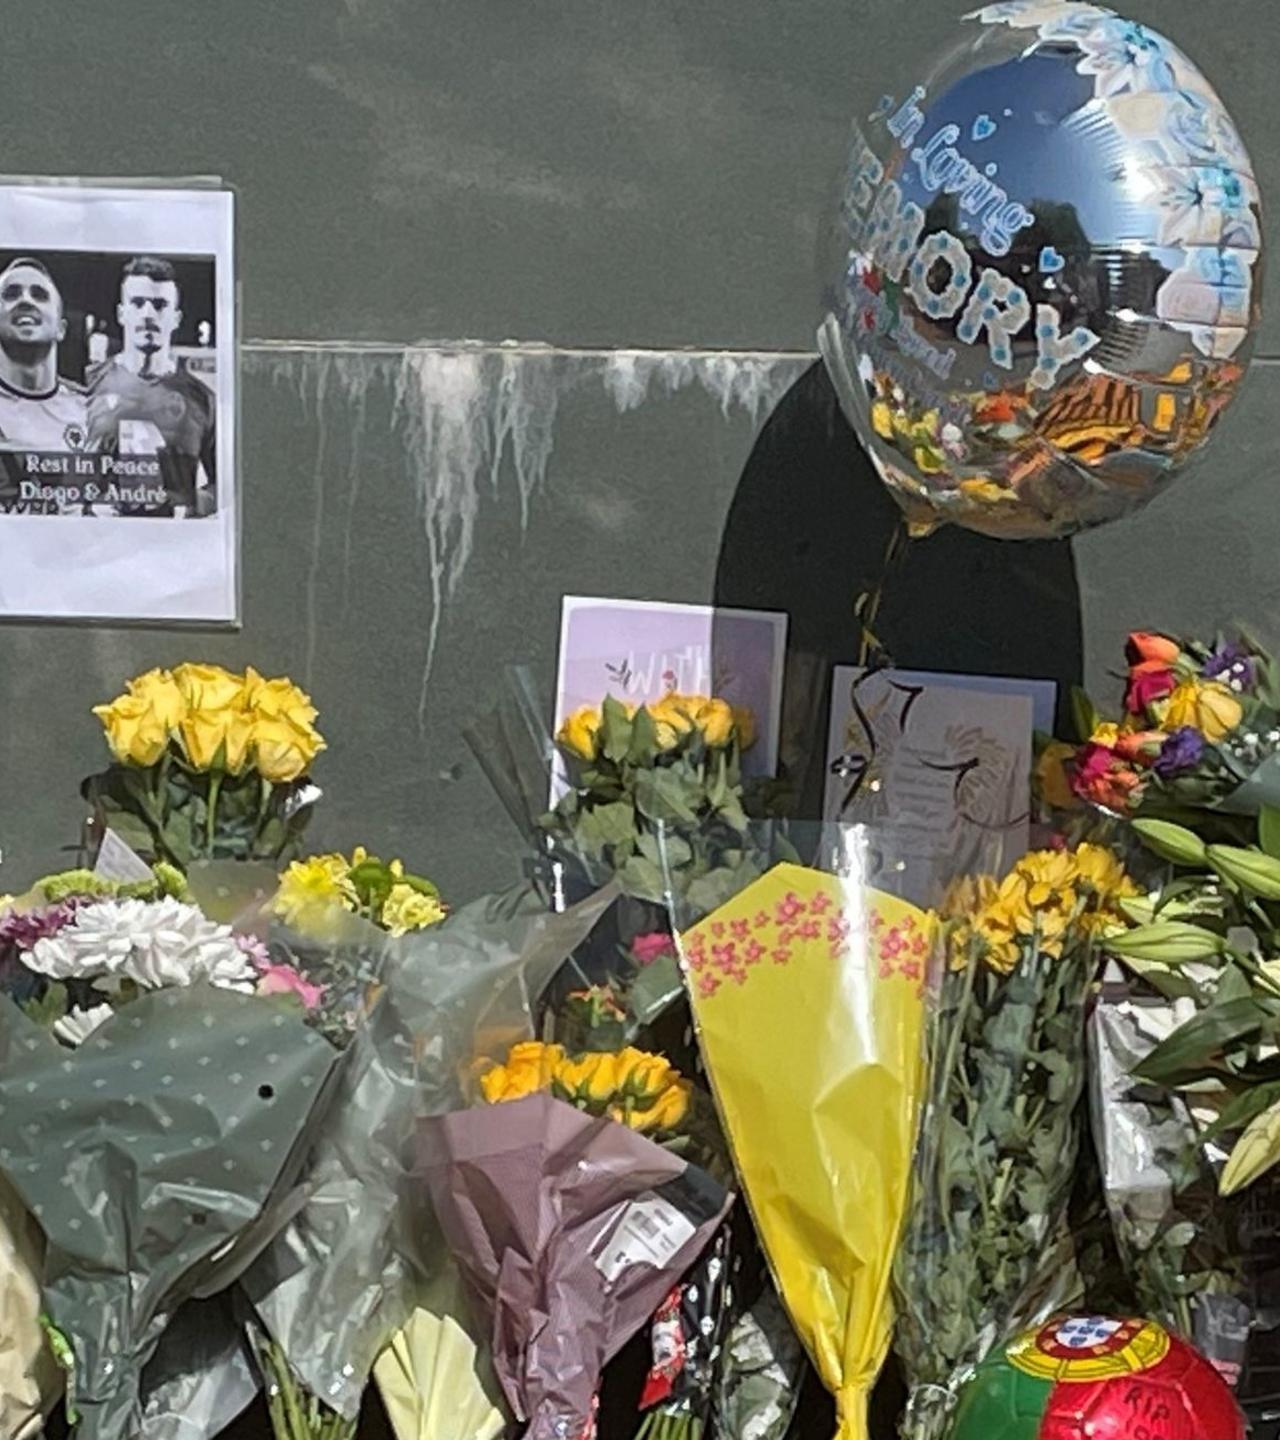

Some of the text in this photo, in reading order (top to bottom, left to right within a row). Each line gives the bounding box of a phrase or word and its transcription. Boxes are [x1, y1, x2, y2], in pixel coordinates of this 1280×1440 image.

[844, 118, 1102, 389] EMORY
[26, 454, 160, 476] Rest in Peace
[19, 481, 80, 505] Diogo
[1124, 1386, 1170, 1423] RIP
